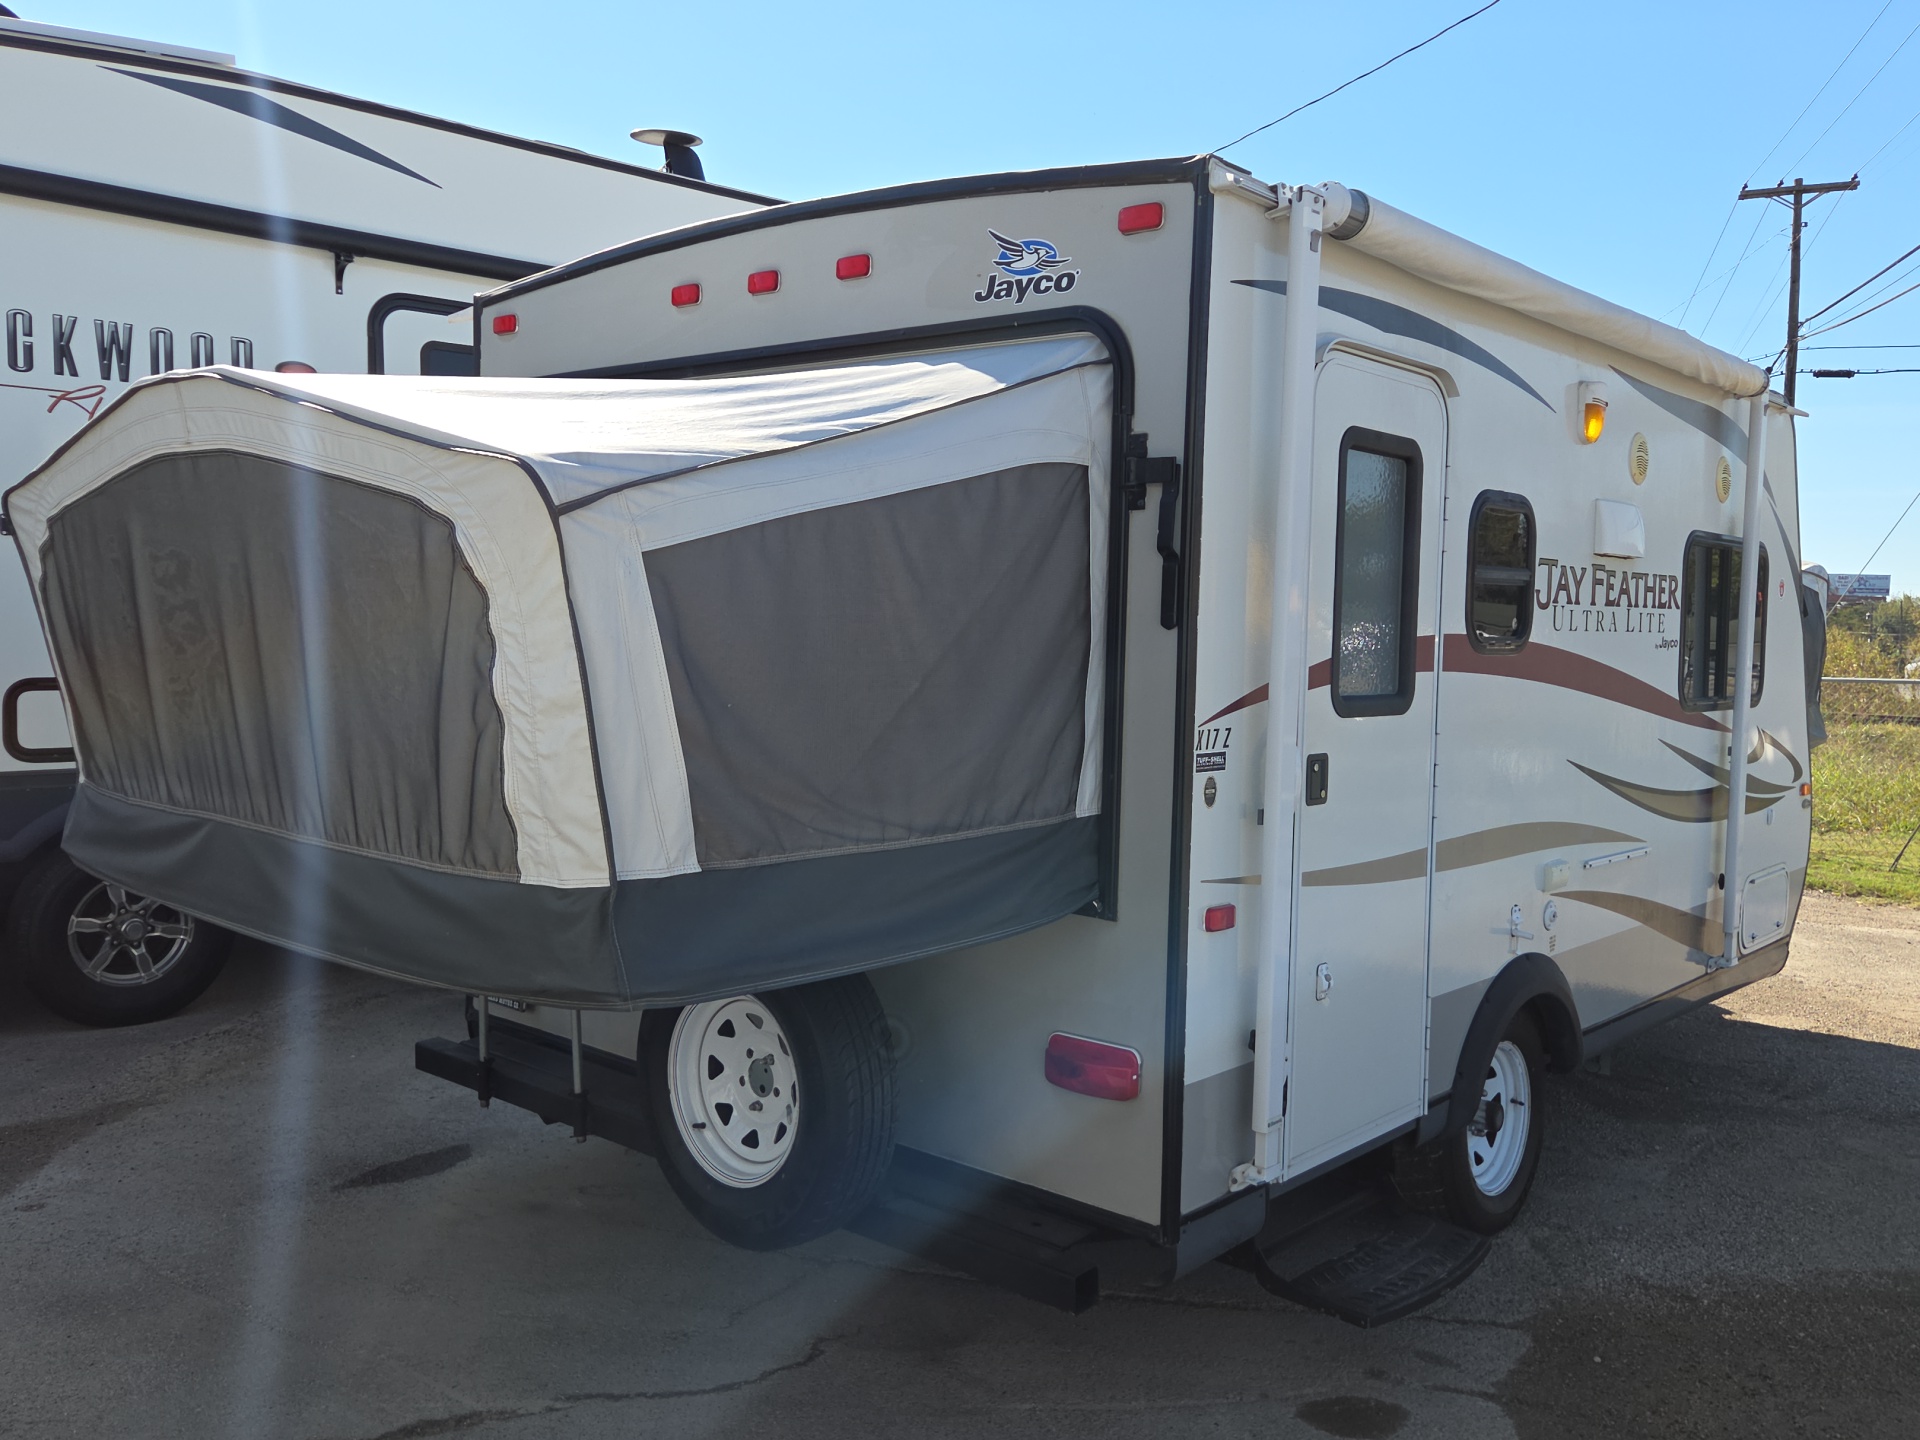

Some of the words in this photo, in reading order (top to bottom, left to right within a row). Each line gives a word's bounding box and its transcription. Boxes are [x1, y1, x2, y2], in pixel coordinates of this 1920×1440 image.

[974, 271, 1076, 304] Jayco
[1535, 557, 1587, 611] JAY
[1590, 563, 1680, 610] FEATHER
[1552, 605, 1618, 632] ULTRA
[1625, 609, 1666, 633] LITE
[1659, 636, 1679, 651] Jayco
[1195, 728, 1220, 751] X17
[1222, 727, 1232, 749] Z
